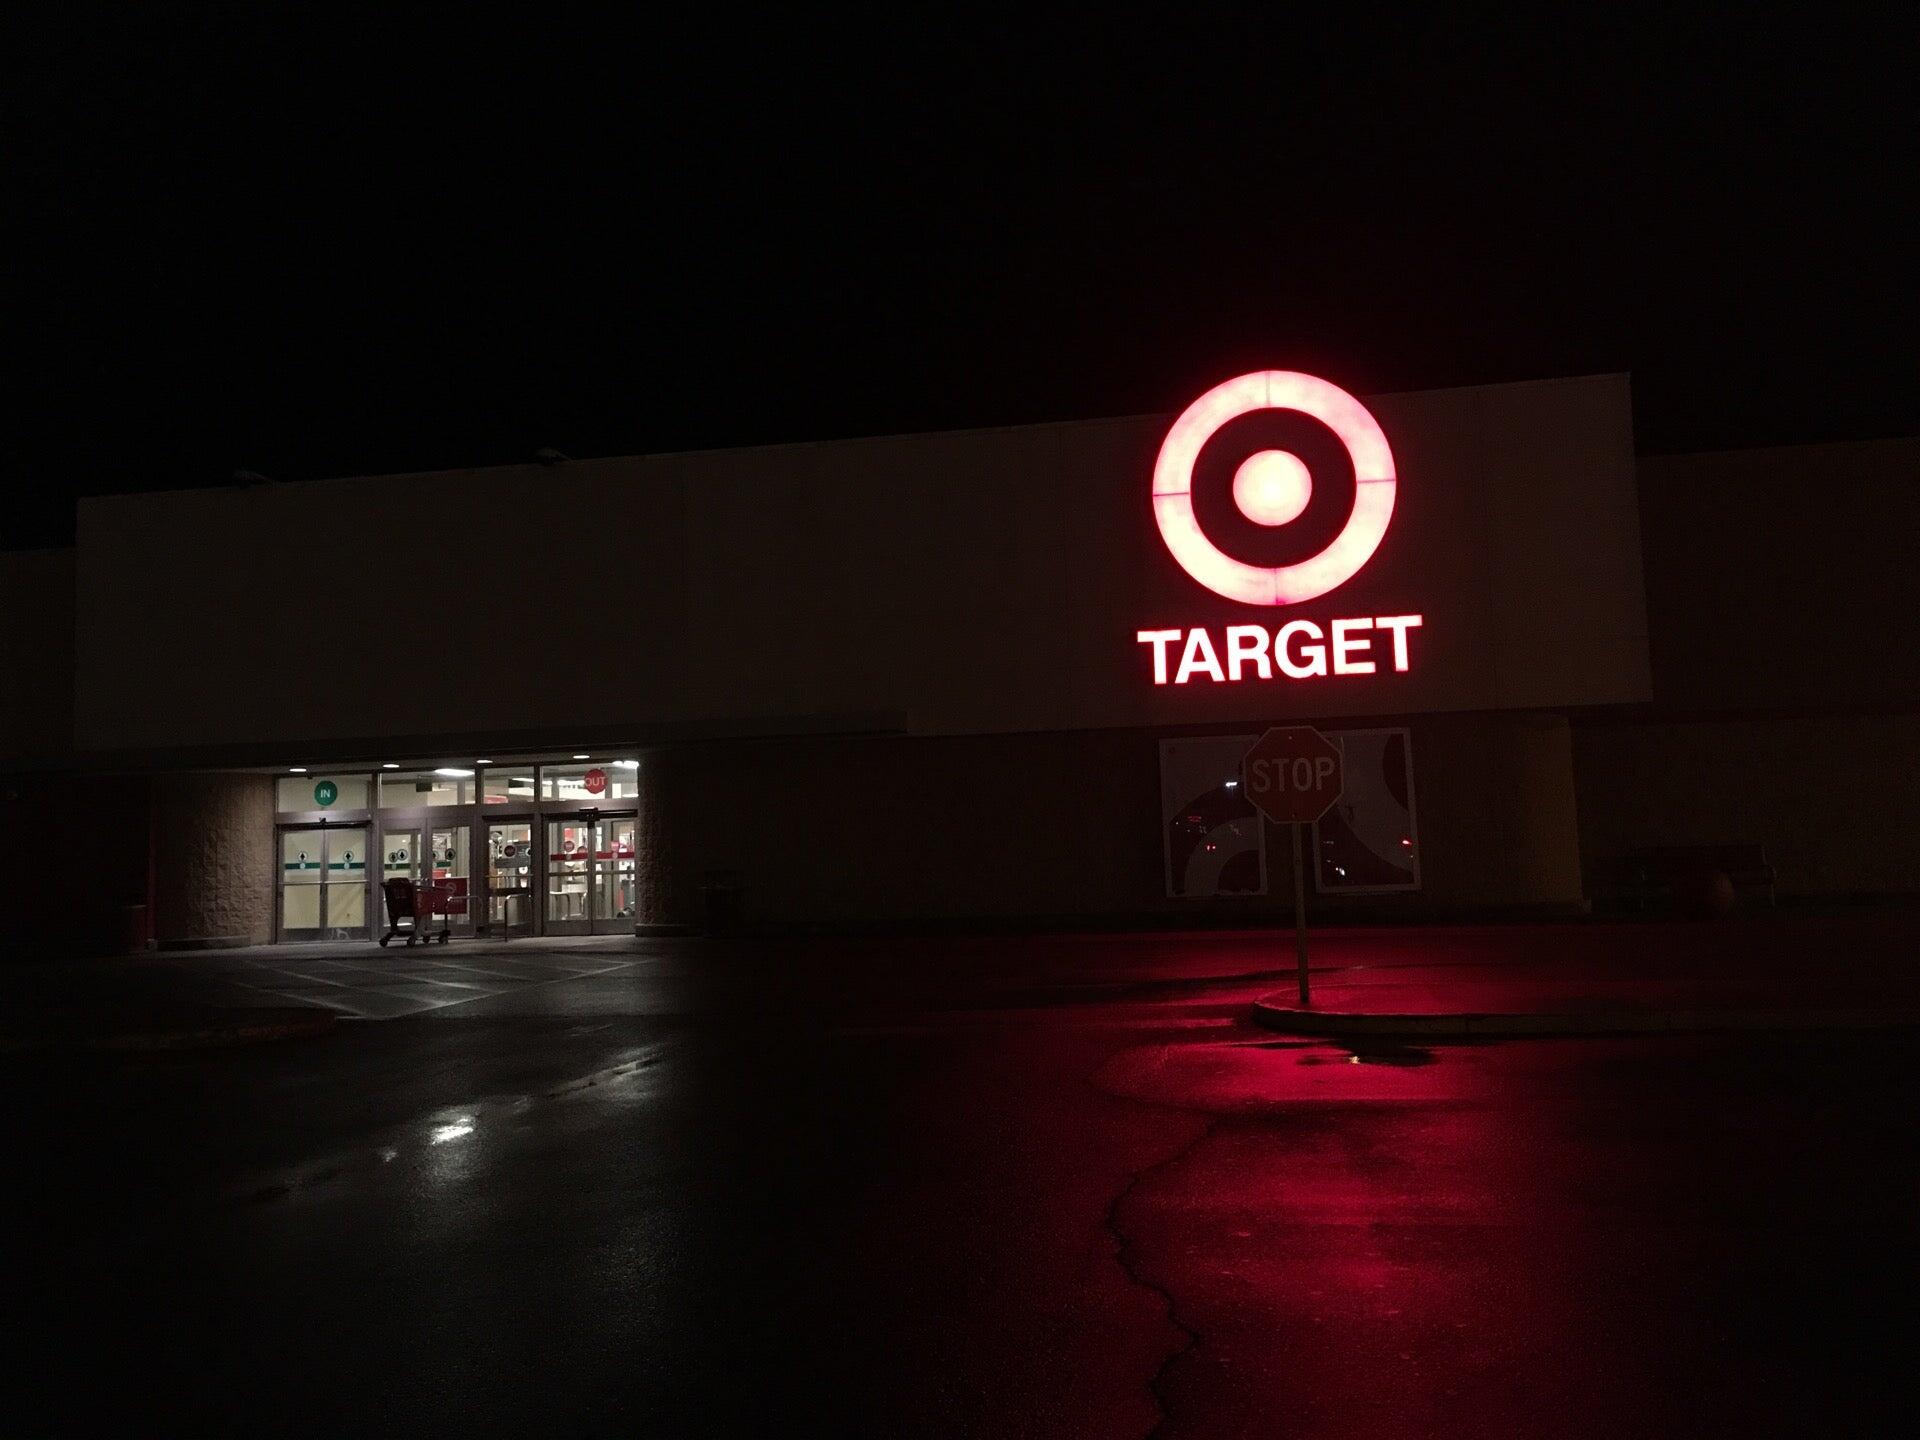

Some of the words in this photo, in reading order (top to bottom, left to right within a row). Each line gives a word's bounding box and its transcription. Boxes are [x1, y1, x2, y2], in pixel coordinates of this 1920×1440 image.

[1136, 614, 1423, 685] TARGET
[585, 776, 606, 787] OUT
[1251, 756, 1335, 793] STOP
[320, 788, 331, 799] IN
